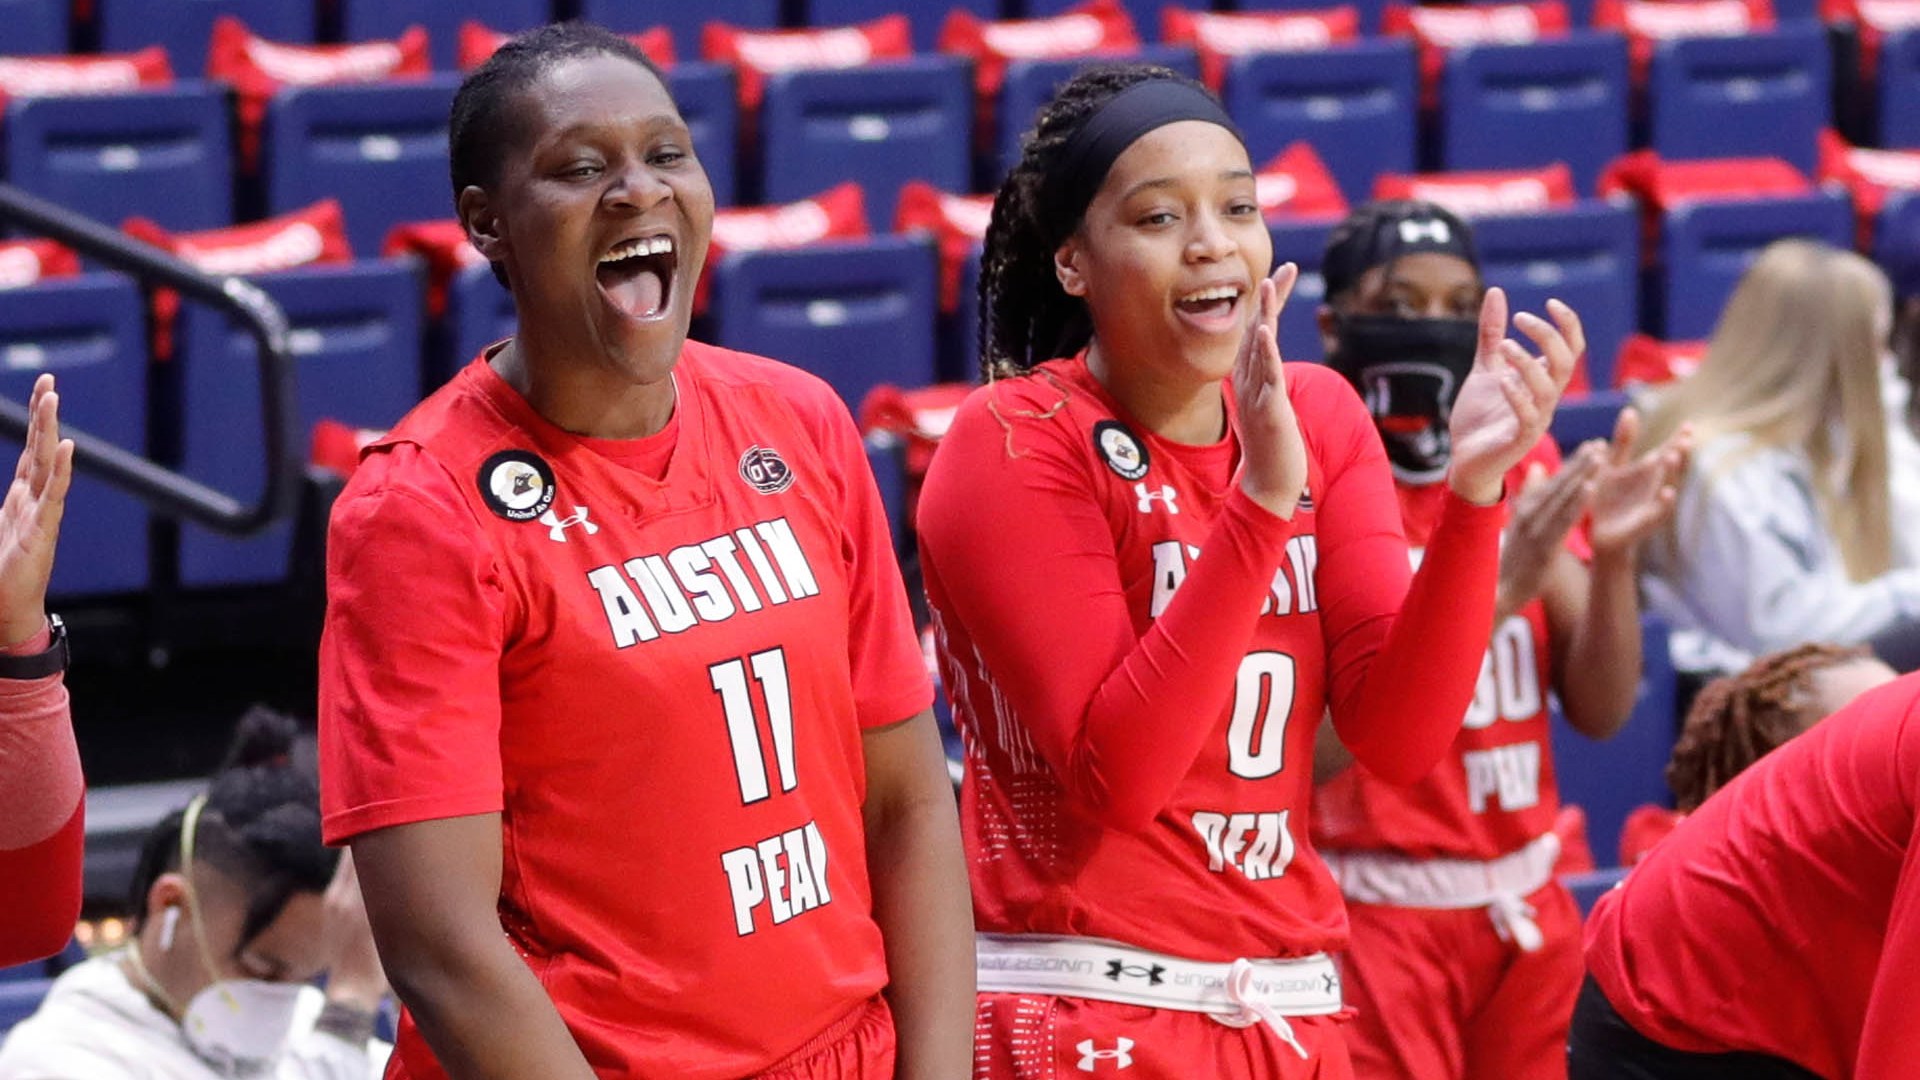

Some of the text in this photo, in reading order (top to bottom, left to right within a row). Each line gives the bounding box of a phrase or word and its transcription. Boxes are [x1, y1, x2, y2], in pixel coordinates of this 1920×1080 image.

[507, 508, 537, 519] United
[587, 516, 820, 648] AUSTIN
[707, 645, 798, 807] 11
[1227, 650, 1296, 780] 0
